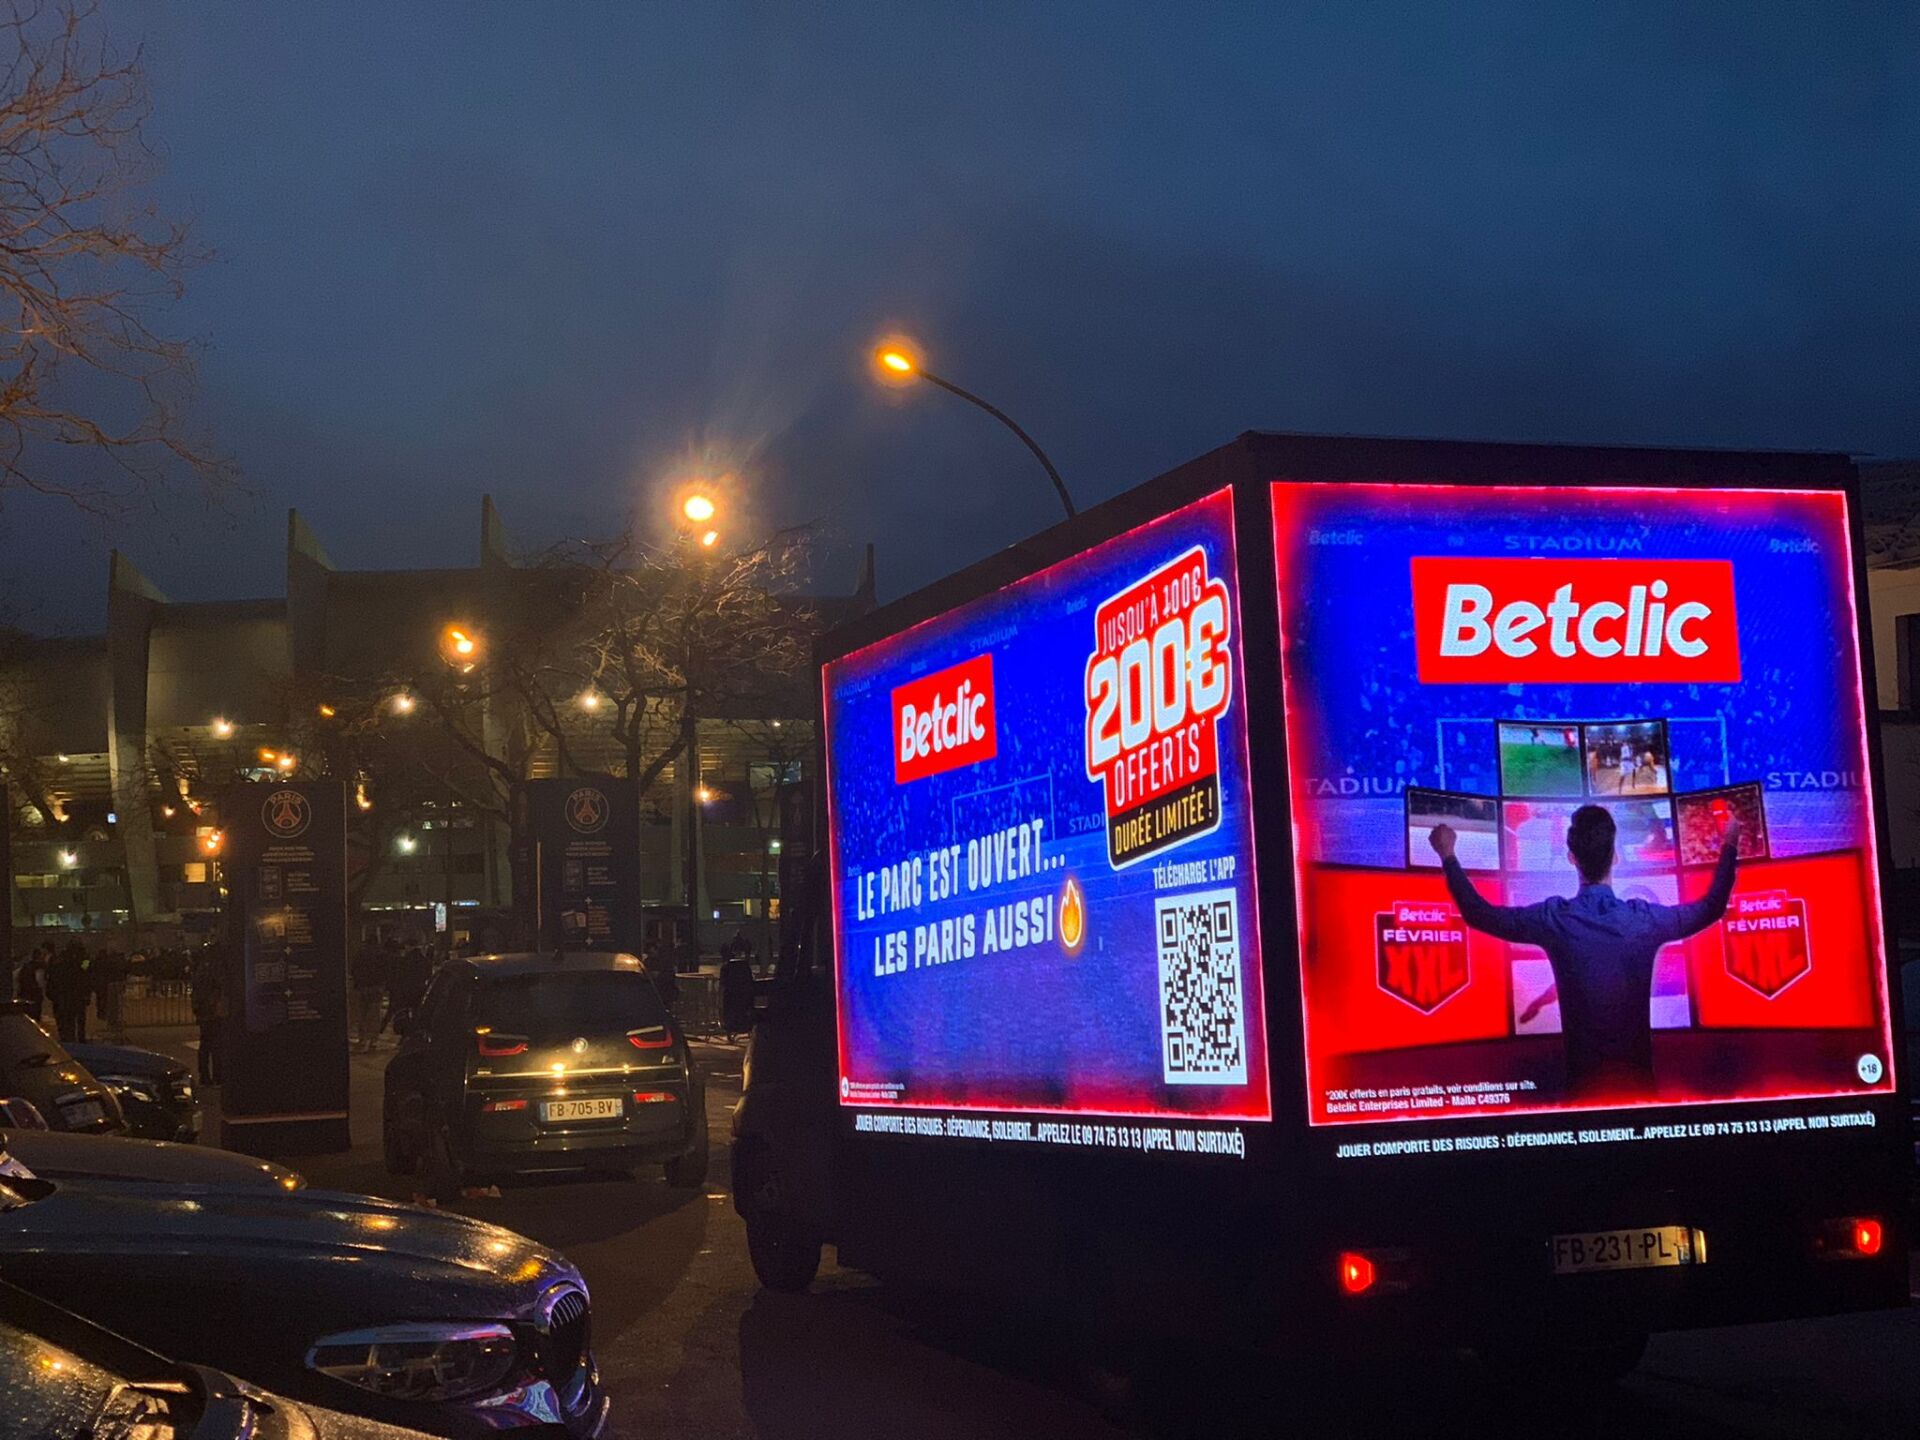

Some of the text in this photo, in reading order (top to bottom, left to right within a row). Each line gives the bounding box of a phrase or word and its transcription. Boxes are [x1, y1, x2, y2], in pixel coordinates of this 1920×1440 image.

[1504, 533, 1643, 553] STADIUM
[1103, 584, 1158, 656] JUSQU'À
[1440, 579, 1712, 658] Betclic
[1089, 596, 1224, 767] 200€
[900, 679, 986, 763] Betclic
[1115, 808, 1152, 855] DURÉE
[1156, 786, 1205, 838] LIMITÉE
[857, 818, 1065, 921] LE PARC EST OUVERT...
[1153, 855, 1236, 889] TÉLÉCHARGE L'APP
[874, 894, 1053, 977] LES PARIS AUSSI
[1383, 927, 1462, 942] FÉVRIER
[1727, 915, 1800, 933] FÉVRIER
[1385, 945, 1464, 1003] XXL
[1730, 934, 1804, 989] XXL
[1389, 1086, 1410, 1099] paris
[1446, 1084, 1462, 1095] voir
[1463, 1082, 1504, 1094] conditions
[1505, 1081, 1518, 1091] sur
[1861, 1063, 1878, 1074] +18
[1326, 1101, 1357, 1113] Betclic
[1359, 1099, 1409, 1112] Enterprises
[1410, 1096, 1444, 1109] Limited
[1038, 1123, 1070, 1144] APPELEZ
[1071, 1124, 1081, 1145] LE
[1082, 1125, 1093, 1145] 09
[1094, 1126, 1105, 1146] 74
[1105, 1126, 1117, 1147] 75
[1118, 1127, 1129, 1148] 13
[1130, 1128, 1141, 1148] 13
[1142, 1128, 1174, 1153] (APPEL
[1176, 1130, 1196, 1152] NON
[1197, 1127, 1245, 1160] SURTAXÉ)
[1336, 1144, 1371, 1158] JOUER
[1374, 1140, 1431, 1156] COMPORTE
[1432, 1138, 1453, 1152] DES
[1455, 1135, 1499, 1151] RISQUES
[1507, 1131, 1578, 1147] DÉPENDANCE,
[1643, 1124, 1687, 1139] APPELEZ
[1688, 1123, 1701, 1136] LE
[1703, 1123, 1715, 1136] 09
[1716, 1122, 1729, 1135] 74
[1731, 1121, 1743, 1134] 75
[1745, 1120, 1757, 1133] 13
[1759, 1119, 1771, 1133] 13
[1773, 1117, 1807, 1134] (APPEL
[1808, 1116, 1829, 1129] NON
[1830, 1110, 1875, 1127] SURTAXÉ)
[1555, 1232, 1672, 1265] FB-231-PL
